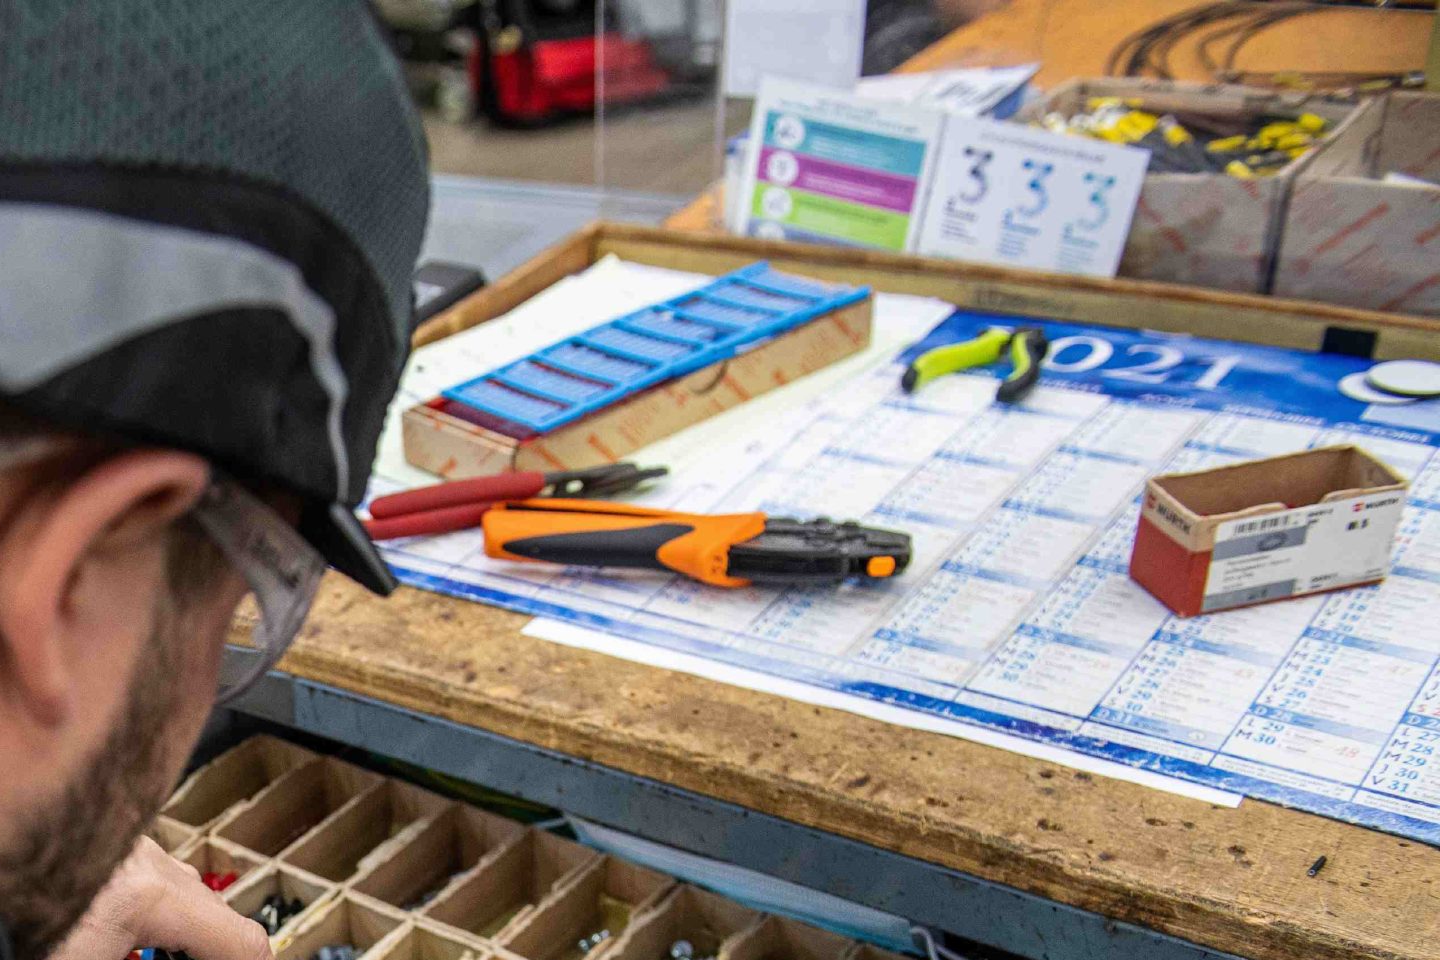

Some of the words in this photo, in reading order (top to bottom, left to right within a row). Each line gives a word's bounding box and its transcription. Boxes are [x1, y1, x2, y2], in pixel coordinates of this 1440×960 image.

[990, 327, 1243, 390] 021
[1254, 732, 1278, 746] 30
[1410, 743, 1435, 756] 28
[1402, 755, 1427, 768] 29
[1395, 767, 1419, 781] 30
[1387, 779, 1410, 794] 31
